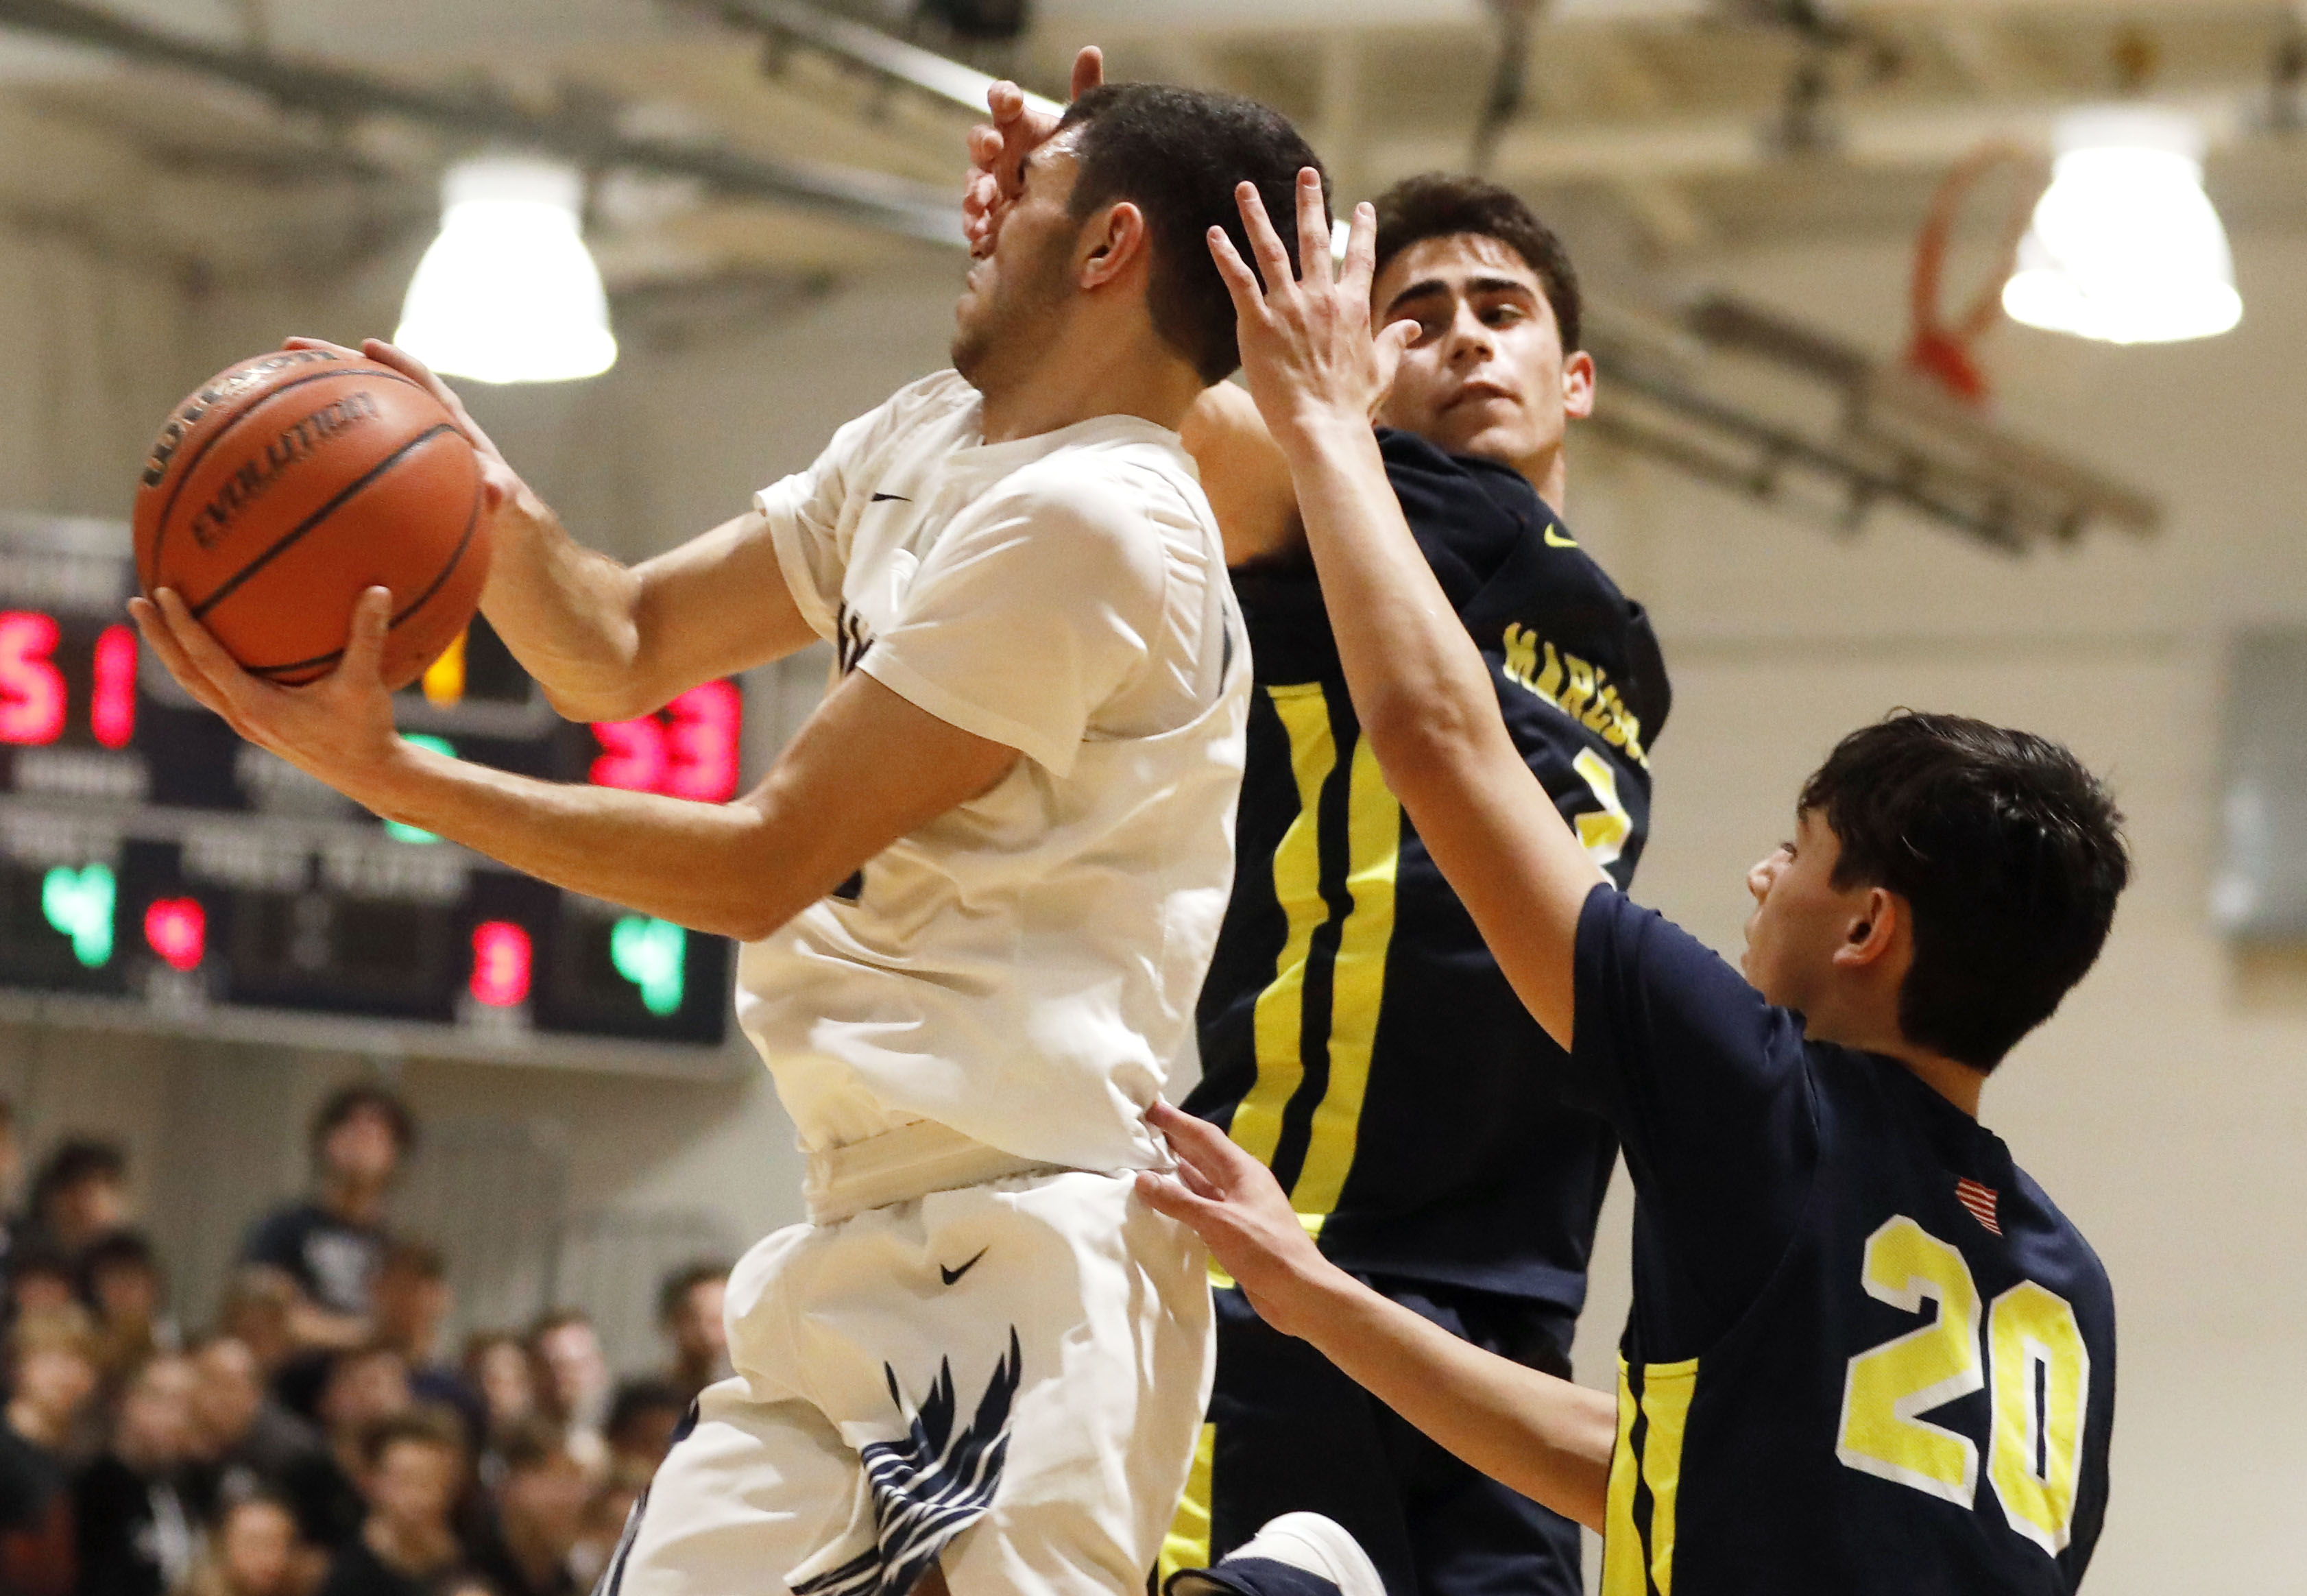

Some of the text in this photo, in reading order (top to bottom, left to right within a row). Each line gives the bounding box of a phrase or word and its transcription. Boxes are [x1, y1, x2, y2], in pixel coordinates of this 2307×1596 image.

[191, 391, 381, 550] EVOLUTION
[0, 609, 137, 751] 51
[1835, 1213, 2091, 1560] 20
